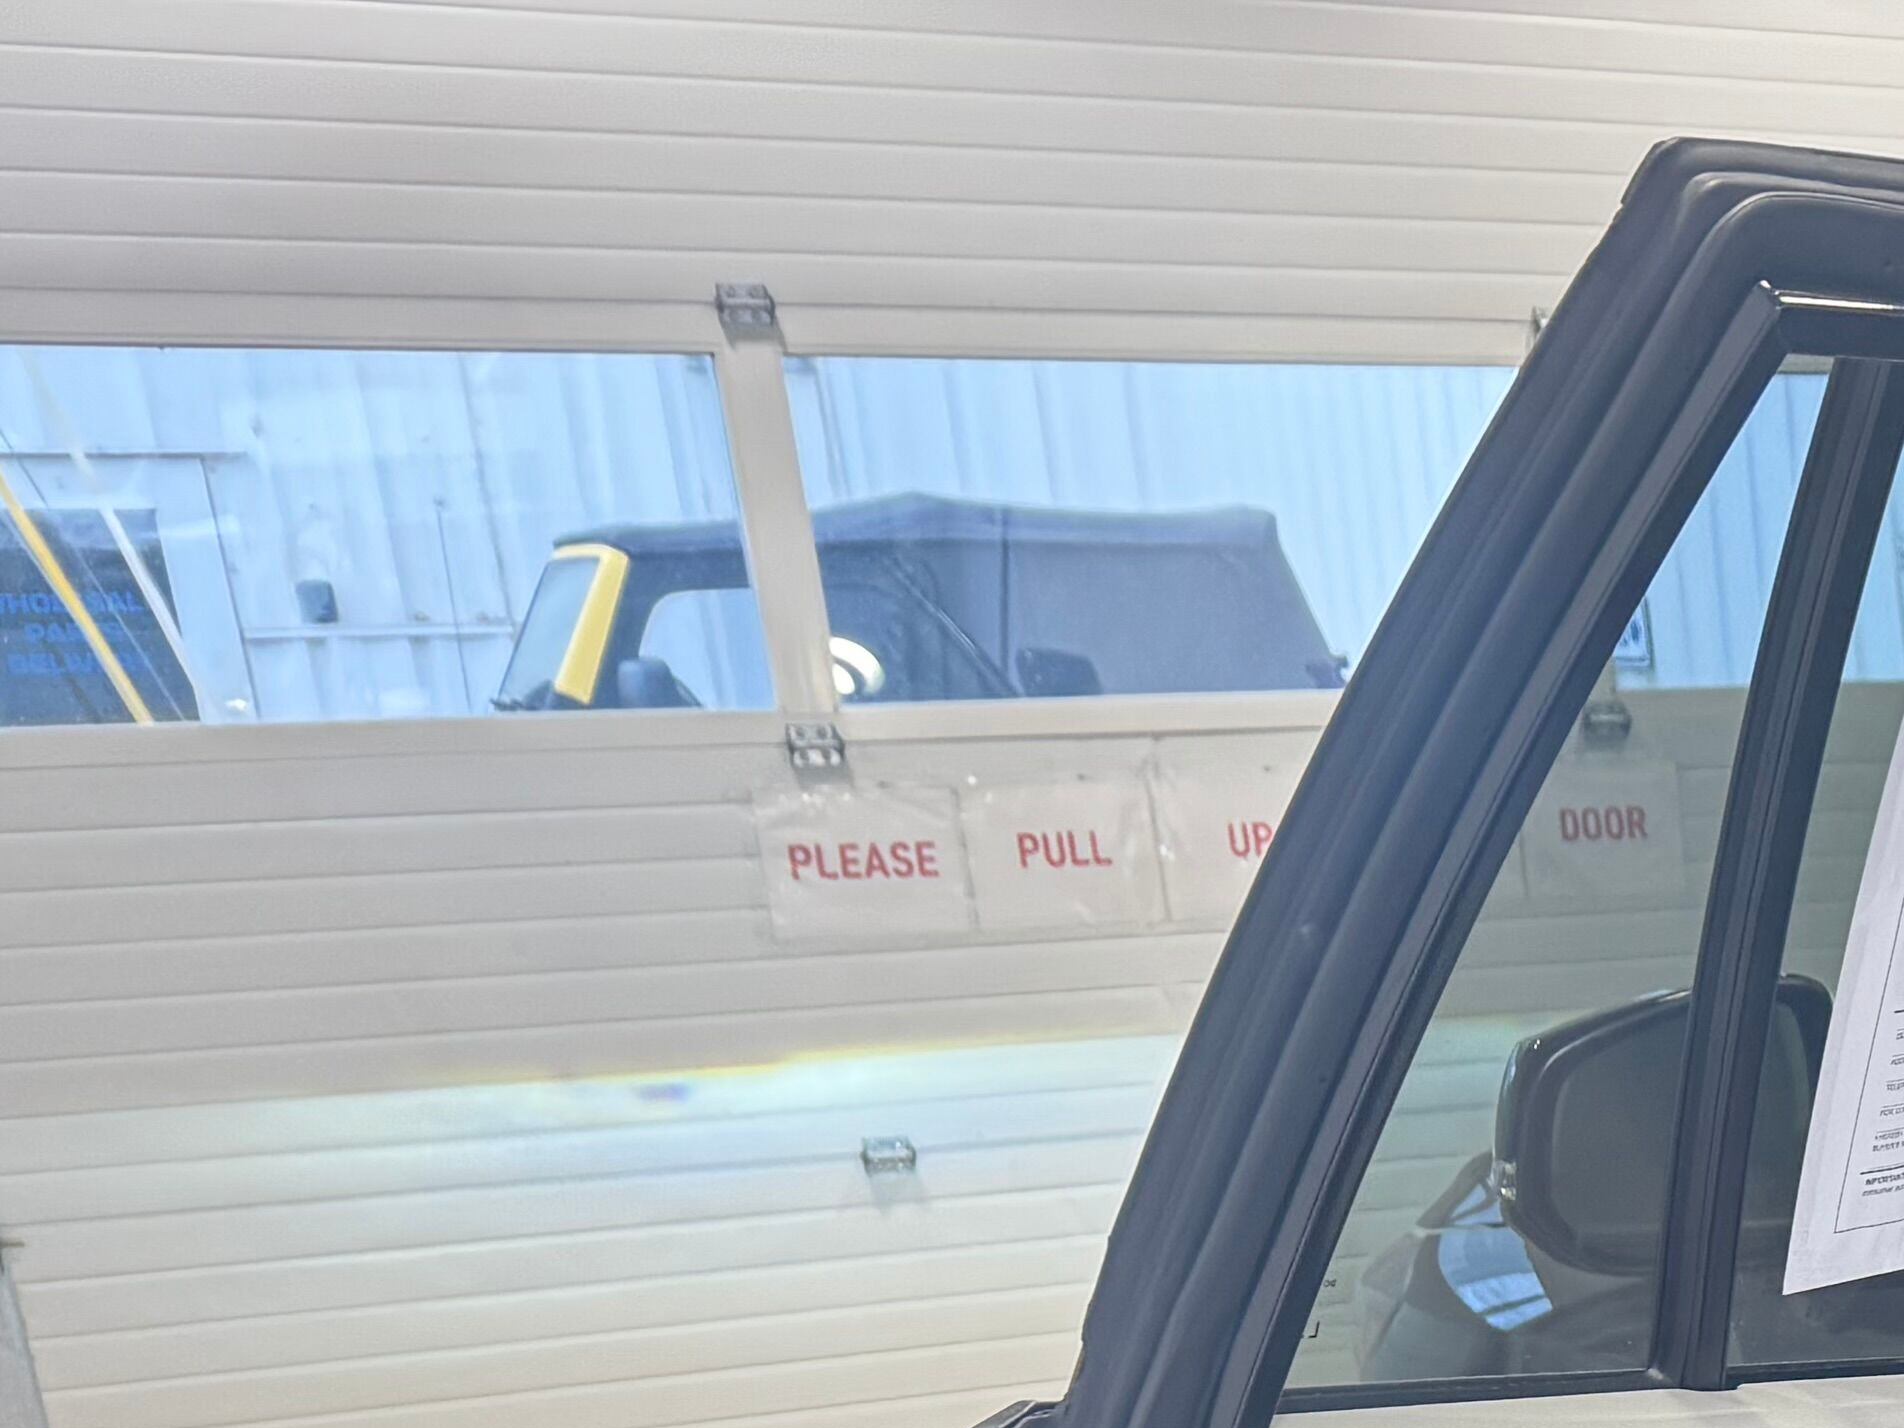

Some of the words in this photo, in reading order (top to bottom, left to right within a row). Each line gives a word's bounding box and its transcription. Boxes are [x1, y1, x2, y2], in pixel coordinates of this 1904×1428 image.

[787, 841, 940, 880] PLEASE
[1017, 830, 1113, 867] PULL
[1227, 821, 1273, 858] UP
[1560, 806, 1648, 840] DOOR
